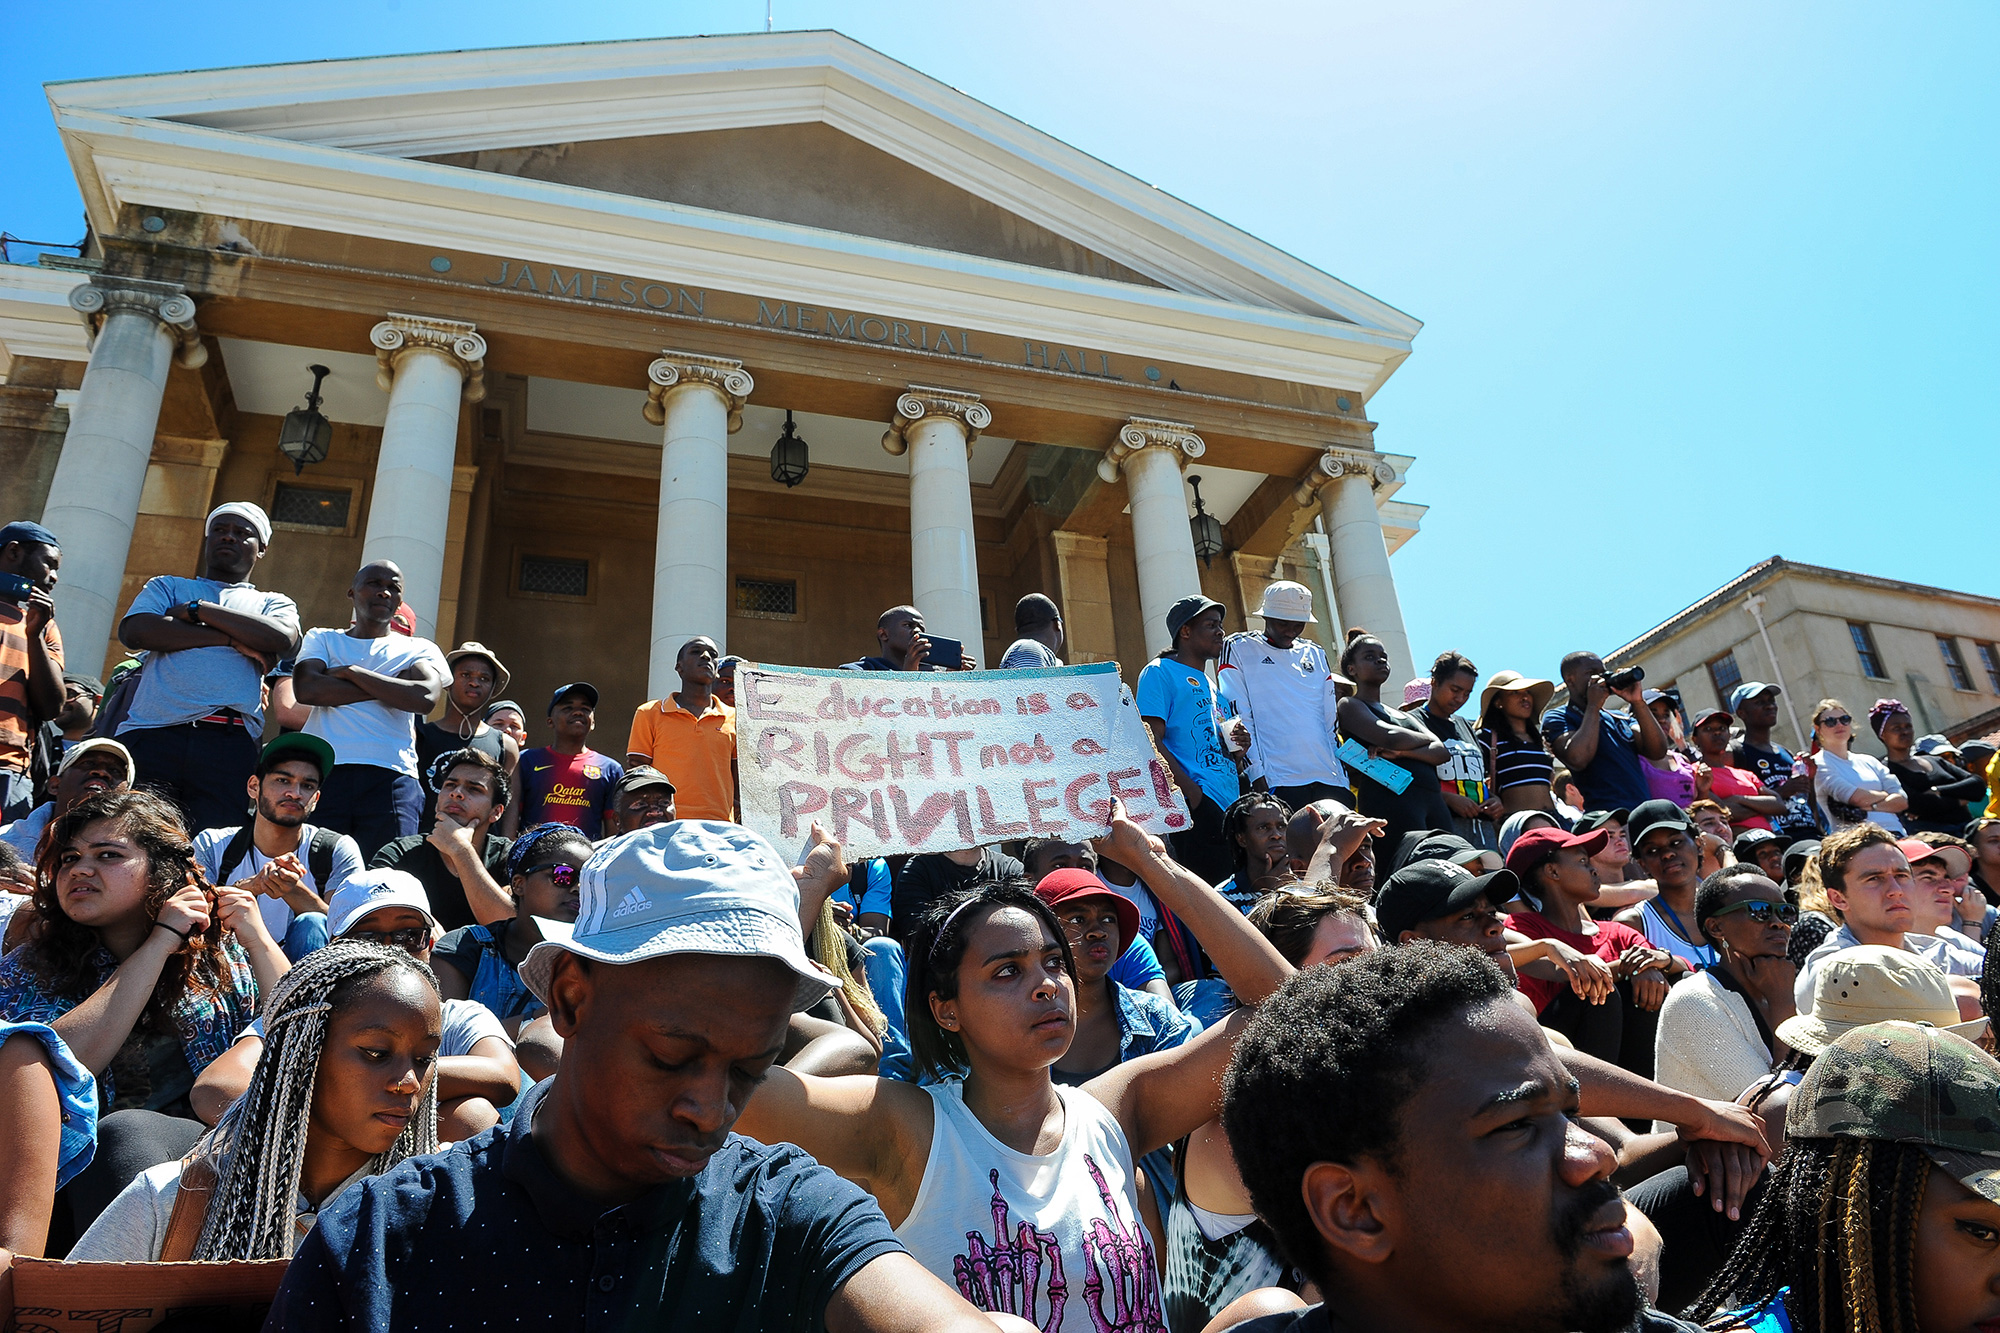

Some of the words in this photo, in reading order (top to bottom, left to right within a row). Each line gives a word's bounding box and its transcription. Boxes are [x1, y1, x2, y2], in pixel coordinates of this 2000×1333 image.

[484, 261, 706, 315] JAMESON
[756, 300, 983, 358] MEMORIAL
[1023, 341, 1123, 379] HALL
[742, 672, 1002, 725] Education
[1066, 692, 1099, 711] a
[756, 726, 975, 783] RIGHT
[980, 733, 1056, 769] not
[1071, 738, 1109, 756] a
[542, 793, 591, 808] foundation
[553, 783, 586, 798] Qatar
[777, 759, 1186, 847] PRIVILEGE!
[612, 900, 653, 919] adidas
